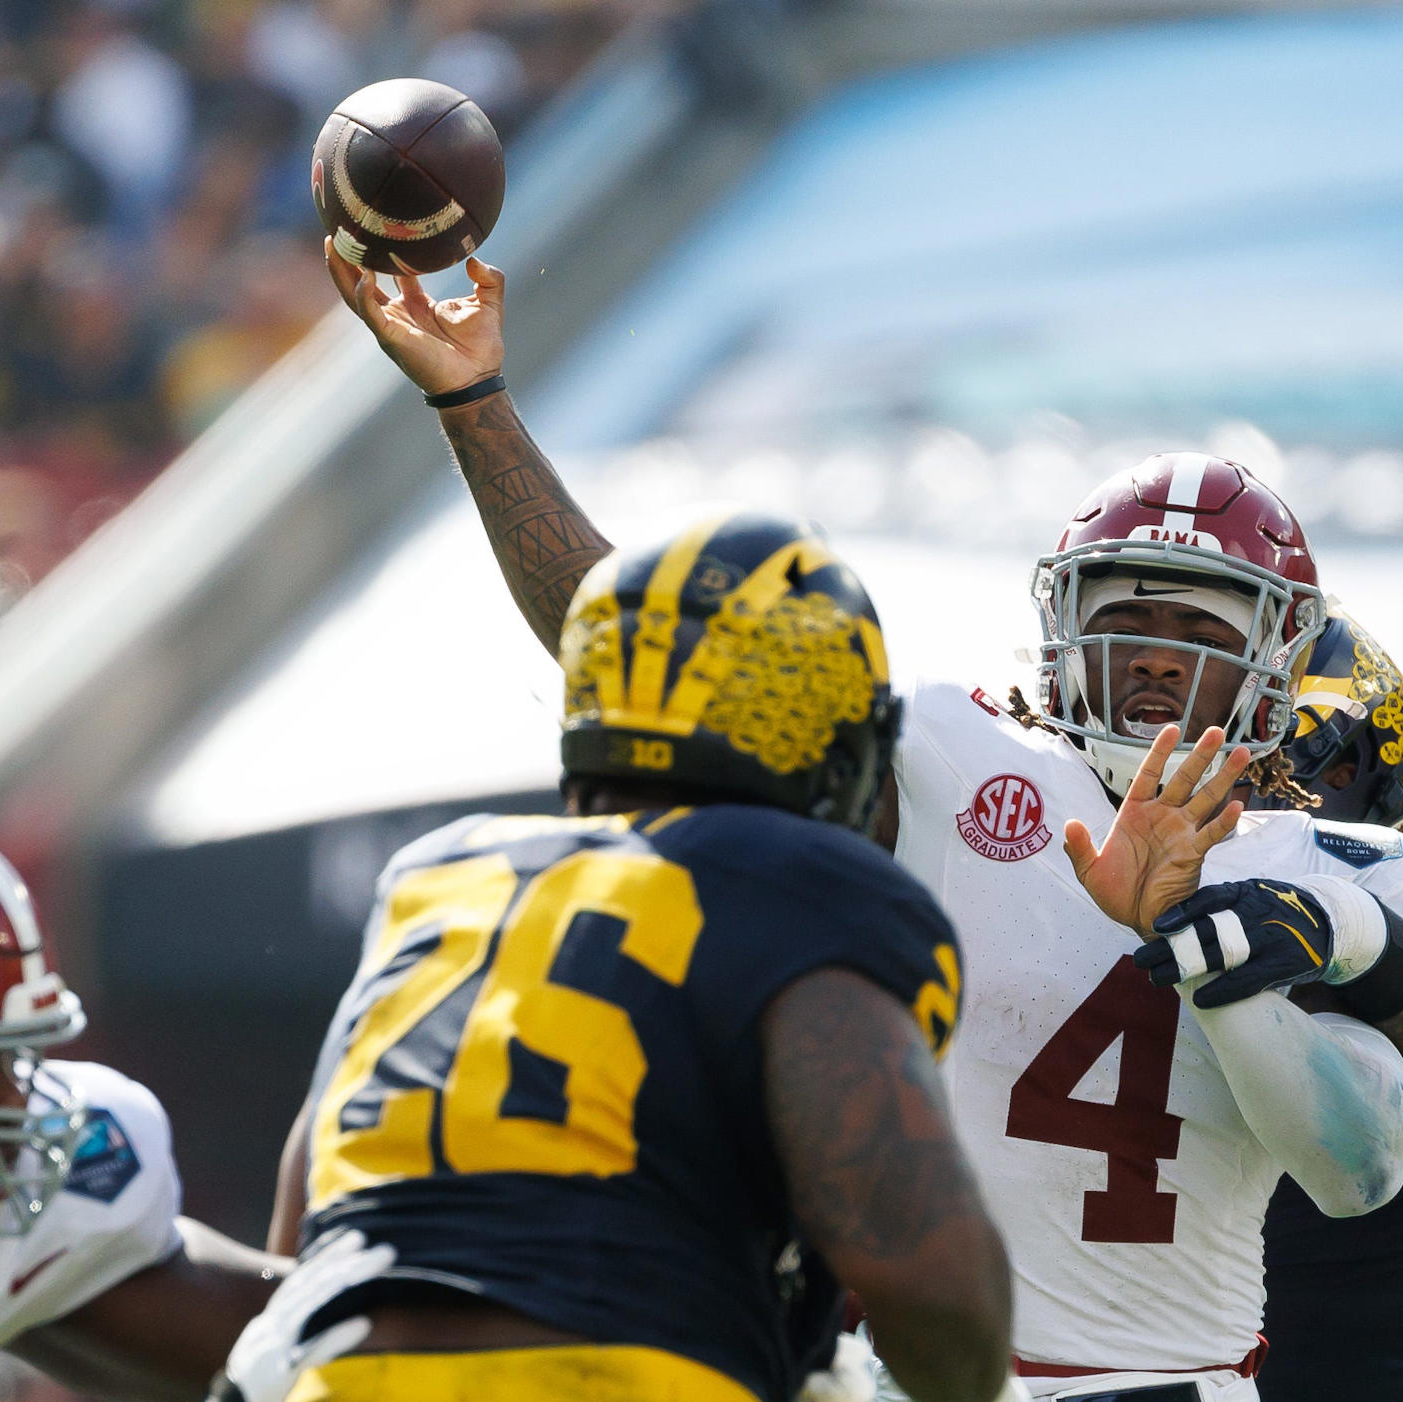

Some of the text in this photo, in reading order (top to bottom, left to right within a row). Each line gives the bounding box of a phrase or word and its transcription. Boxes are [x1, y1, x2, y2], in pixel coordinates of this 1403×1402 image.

[1149, 528, 1199, 547] BAMA
[978, 778, 1038, 839] SEC
[963, 826, 1037, 860] GRADUATE
[305, 847, 705, 1209] 26
[1004, 953, 1185, 1244] 4
